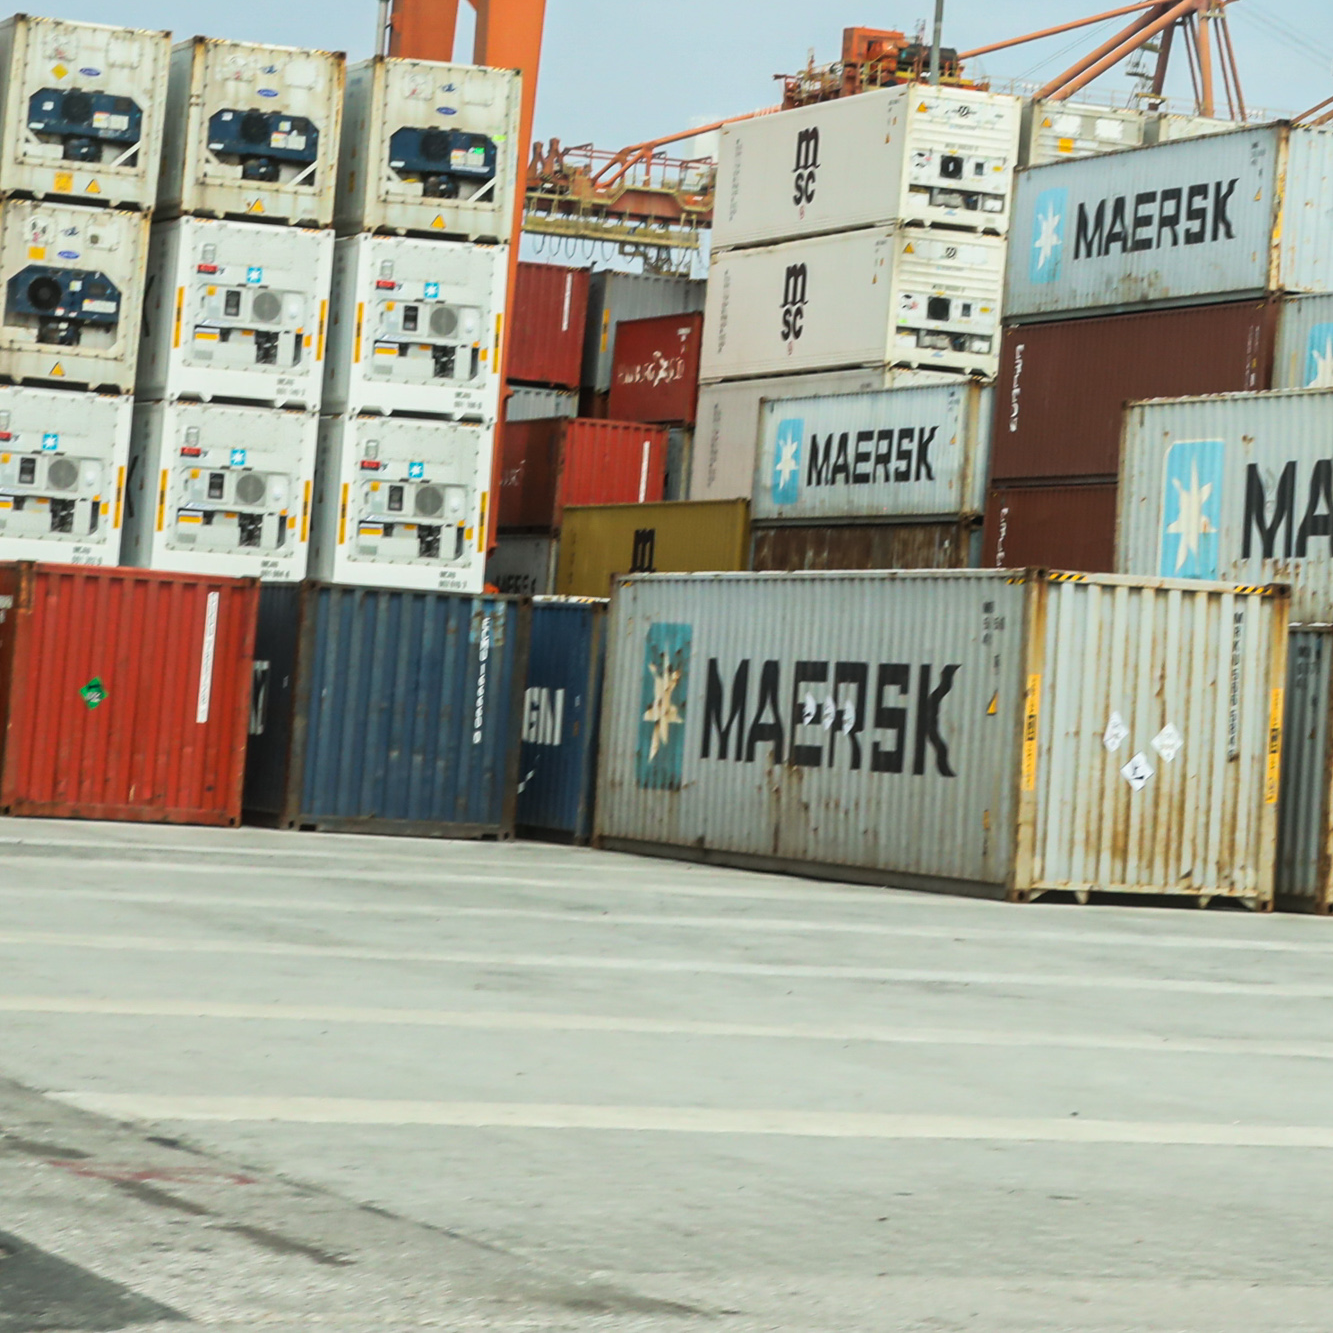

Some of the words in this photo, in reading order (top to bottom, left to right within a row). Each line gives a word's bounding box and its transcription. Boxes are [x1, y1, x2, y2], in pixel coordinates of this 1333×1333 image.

[1073, 178, 1241, 261] MAERSK
[807, 425, 940, 488] MAERSK
[701, 657, 962, 777] MAERSK
